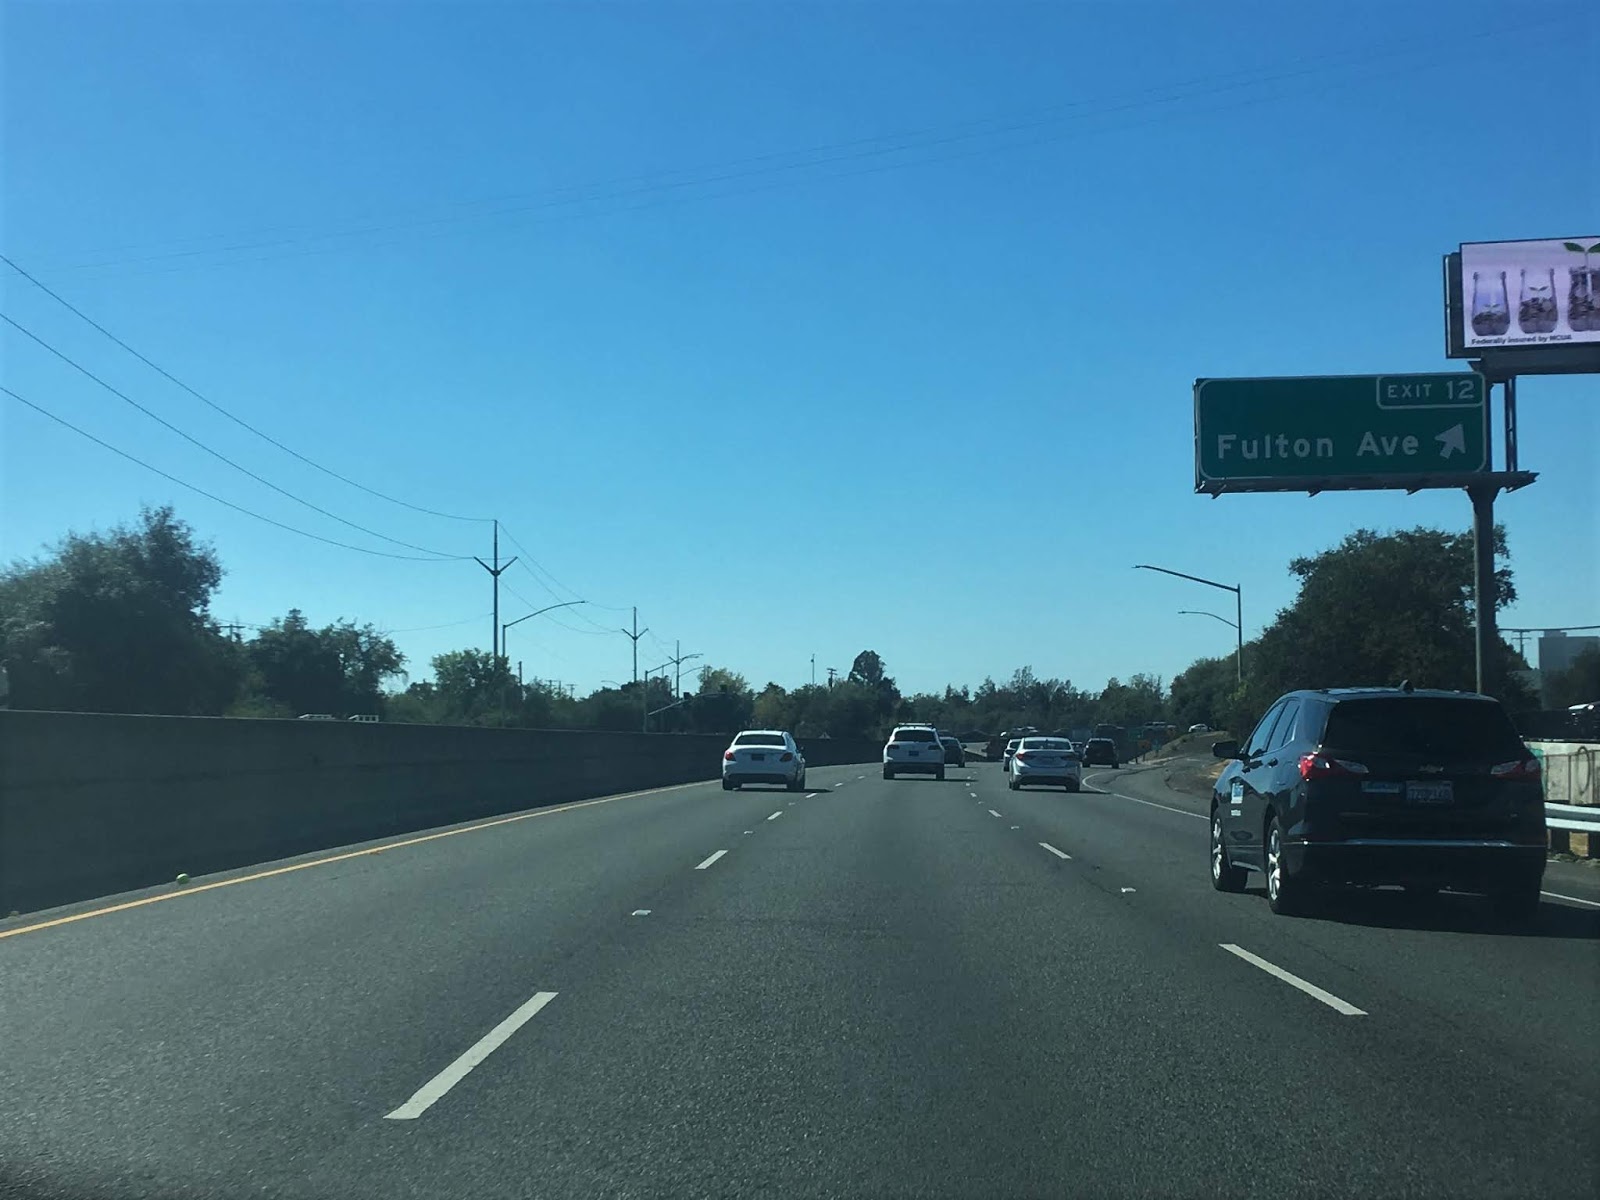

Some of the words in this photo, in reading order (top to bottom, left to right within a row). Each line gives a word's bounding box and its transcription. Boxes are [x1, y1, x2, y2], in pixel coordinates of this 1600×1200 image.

[1538, 335, 1548, 343] by
[1387, 383, 1432, 398] EXIT
[1447, 380, 1475, 400] 12
[1217, 433, 1334, 459] Fulton
[1356, 431, 1419, 456] Ave
